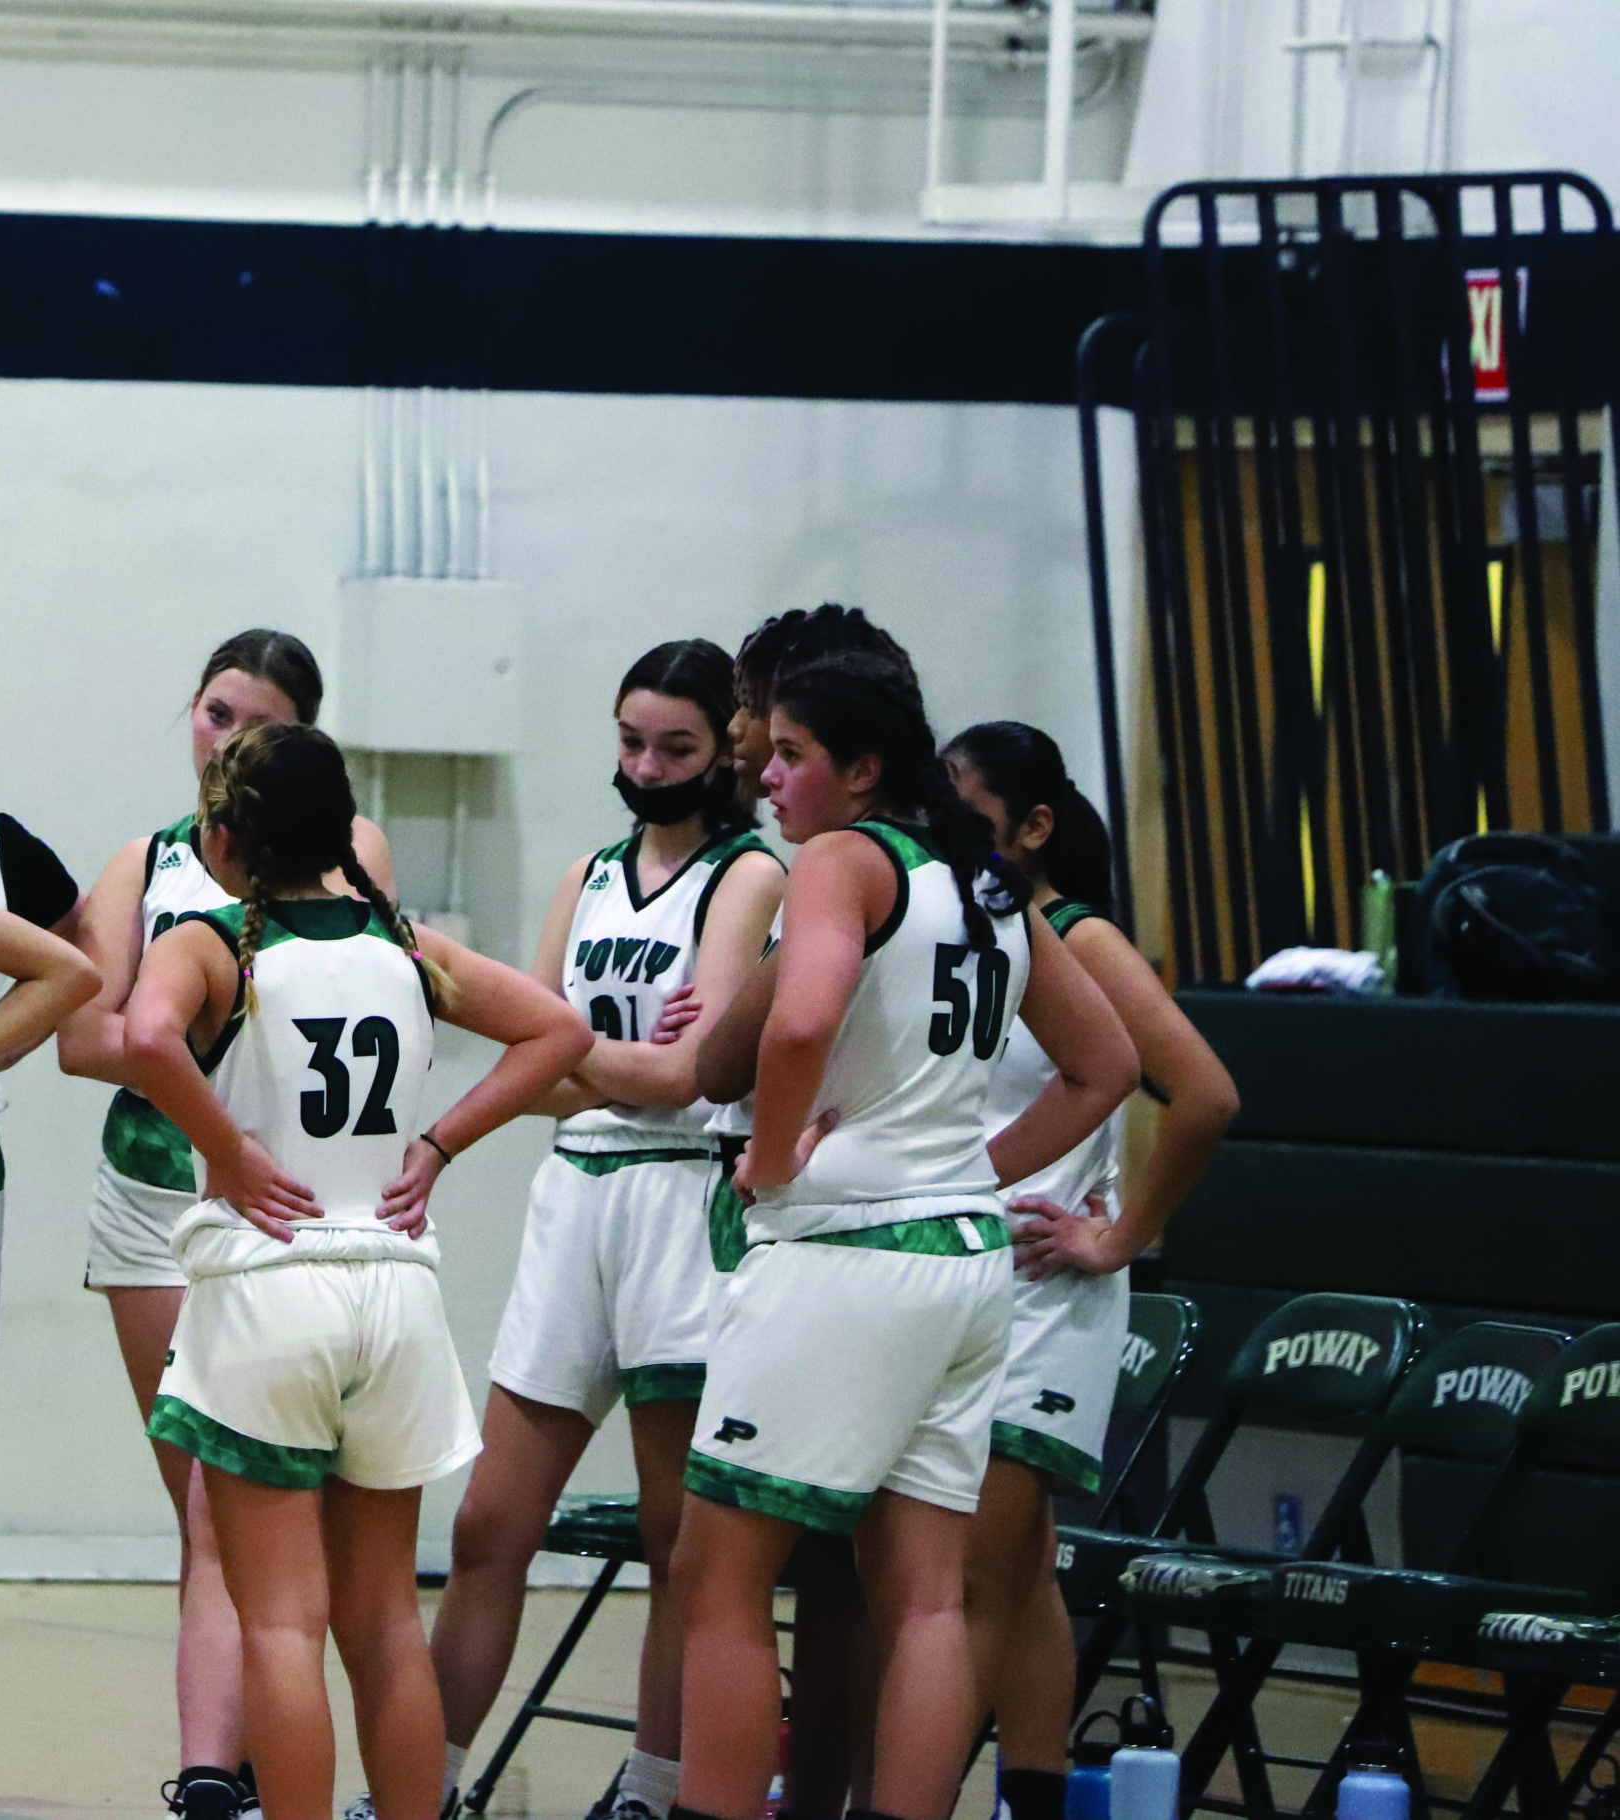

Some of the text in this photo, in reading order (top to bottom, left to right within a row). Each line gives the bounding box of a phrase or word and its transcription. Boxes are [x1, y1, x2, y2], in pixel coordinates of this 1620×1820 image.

[928, 942, 1010, 1061] 50
[291, 1015, 400, 1139] 32
[1263, 1330, 1380, 1376] POWAY
[1031, 1389, 1076, 1416] P
[1432, 1365, 1535, 1416] POWAY
[713, 1416, 758, 1444] P
[1284, 1572, 1349, 1604] TITANS
